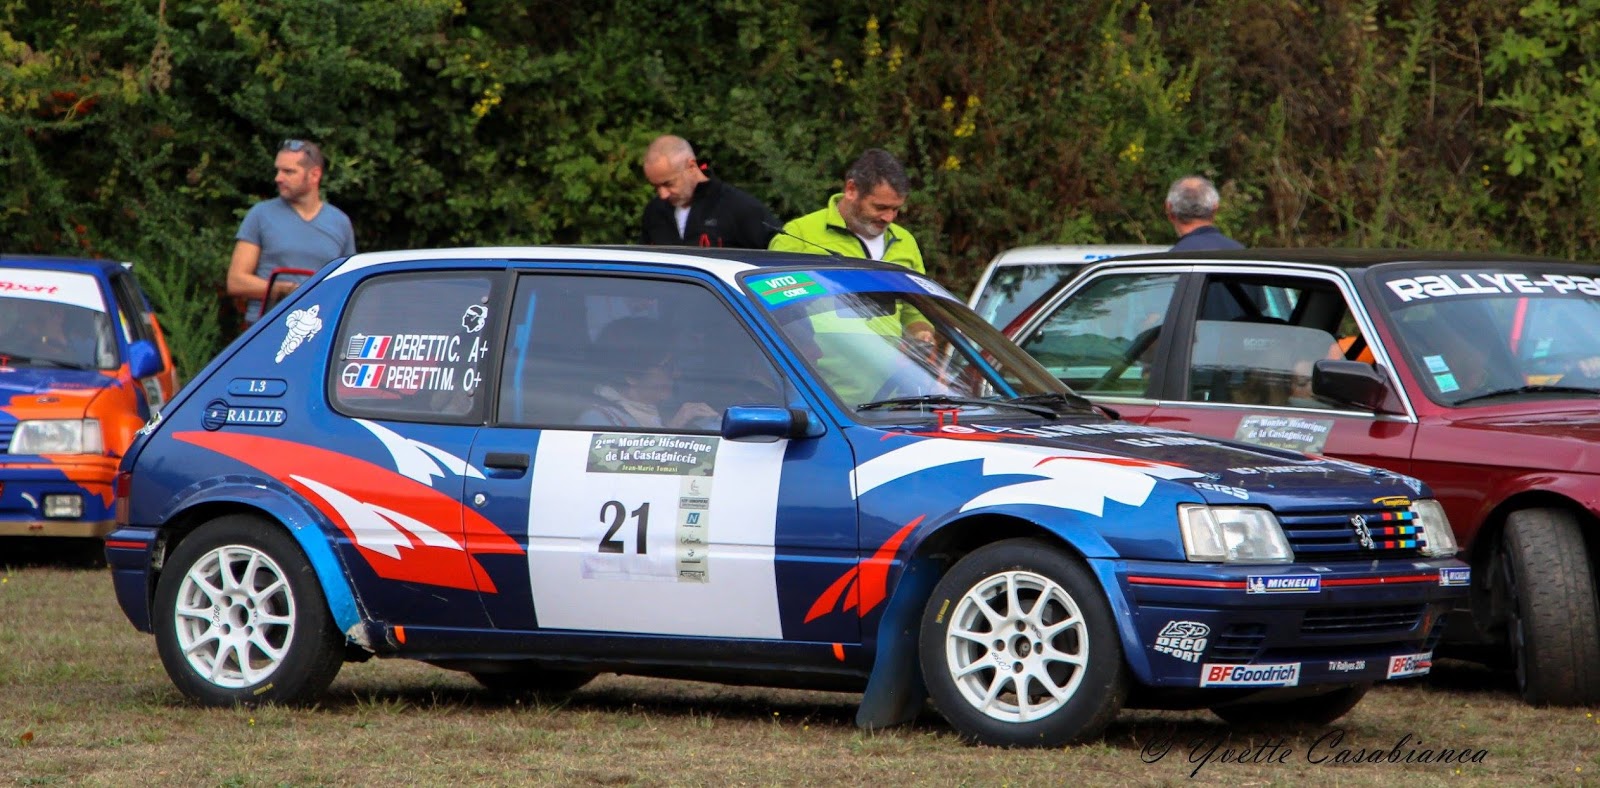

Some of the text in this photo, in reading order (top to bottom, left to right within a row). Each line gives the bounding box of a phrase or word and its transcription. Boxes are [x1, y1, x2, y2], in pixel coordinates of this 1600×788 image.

[765, 275, 797, 289] VITO
[467, 336, 488, 363] A+
[249, 380, 267, 393] 1.3
[226, 409, 283, 423] RALLYE
[618, 437, 655, 447] Montée
[658, 437, 712, 453] Historique
[605, 450, 697, 464] de la Castagniccia
[622, 464, 678, 473] Jean-Marie Tomasi
[598, 500, 650, 555] 21
[1267, 577, 1317, 588] MICHELIN
[1155, 637, 1208, 652] DECO
[1153, 644, 1203, 663] SPORT
[1207, 664, 1296, 682] BFGoodrich
